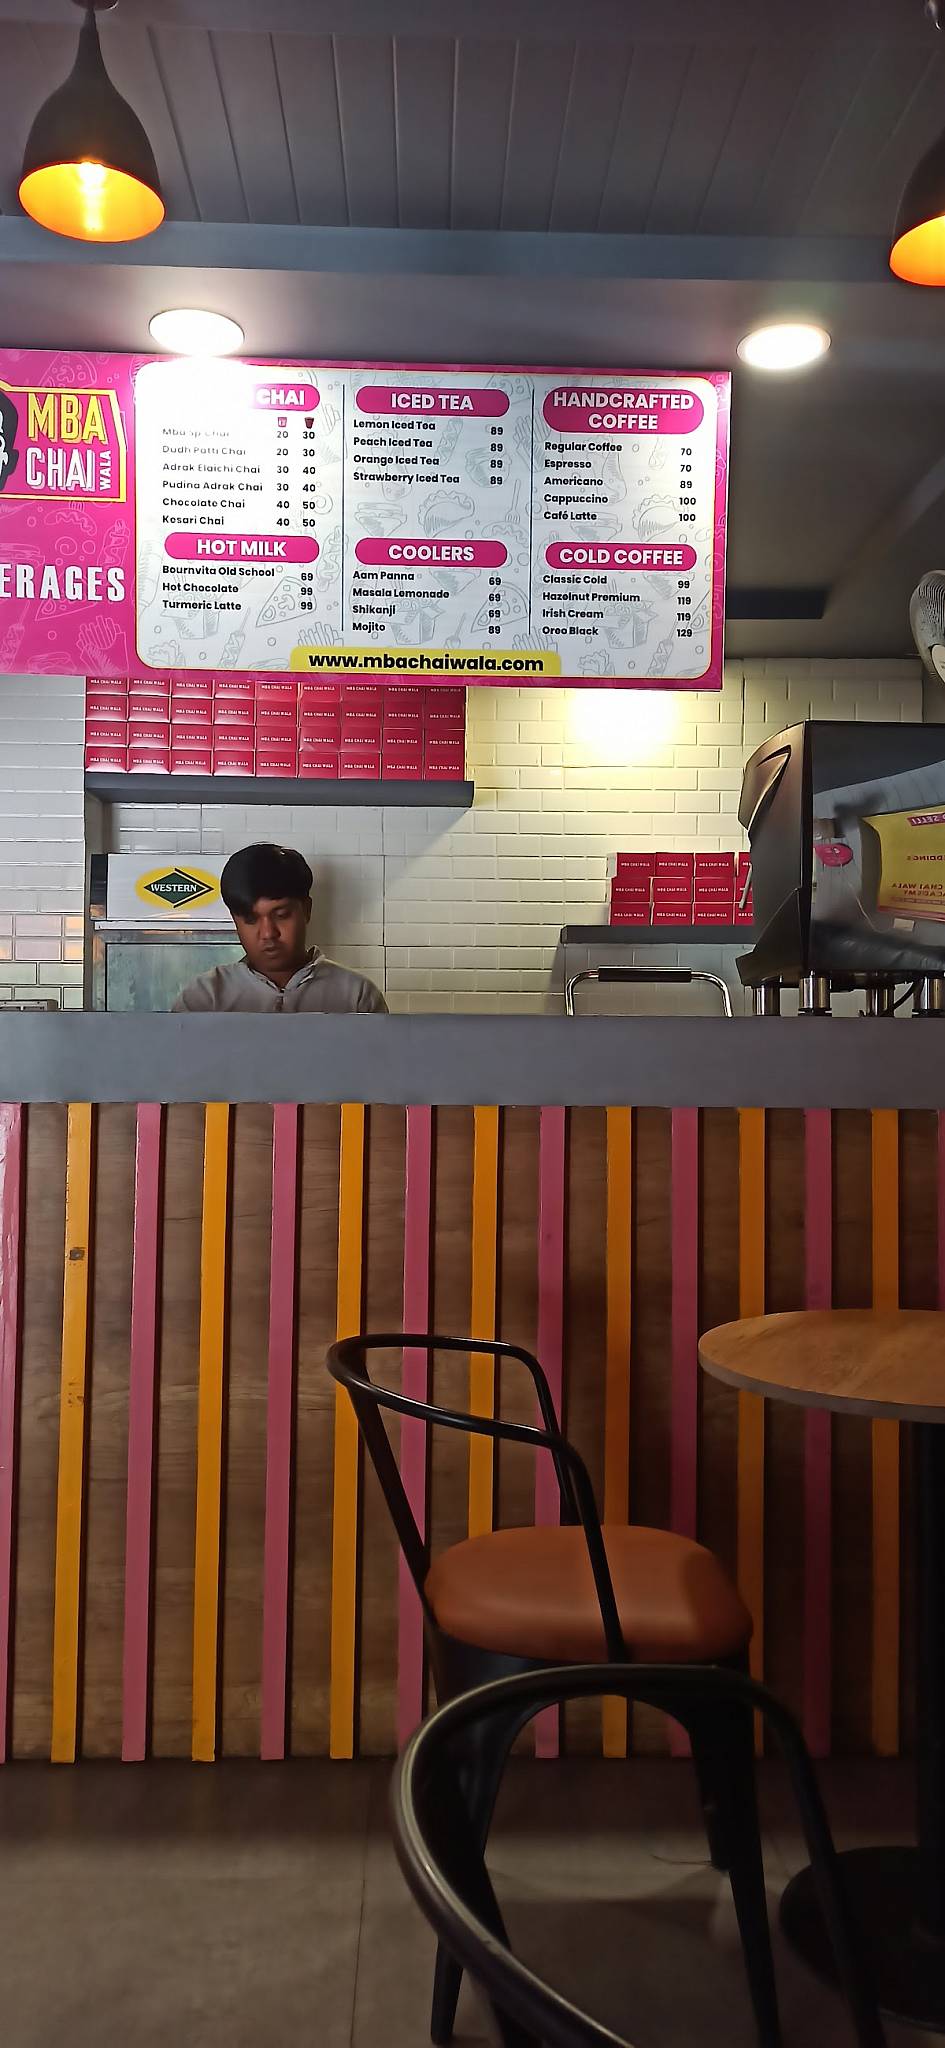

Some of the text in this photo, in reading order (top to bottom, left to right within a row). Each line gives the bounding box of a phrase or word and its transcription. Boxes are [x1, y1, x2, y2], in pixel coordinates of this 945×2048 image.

[256, 388, 305, 406] CHAI
[392, 394, 473, 410] ICED TEA
[553, 391, 694, 410] HANDCRAFTED
[28, 392, 108, 444] MBA
[589, 414, 657, 429] COFFEE
[277, 430, 289, 439] 20
[302, 431, 316, 440] 30
[353, 419, 504, 436] Lemon Iced Tea 89
[162, 445, 191, 453] Dudh
[221, 447, 246, 455] Chai
[276, 448, 289, 457] 20
[303, 448, 315, 457] 30
[353, 436, 504, 453] Peach Iced Tea 89
[544, 441, 692, 456] Regular Coffee 70
[162, 463, 316, 475] Adrak Elaichi Chai 30 40
[353, 454, 503, 469] Orange Iced Tea 89
[544, 458, 692, 473] Espresso 70
[26, 447, 95, 492] CHAI
[99, 450, 111, 491] WALA
[353, 471, 503, 485] Strawberry Iced Tea 89
[543, 475, 693, 489] Americano 89
[162, 480, 316, 493] Pudina Adrak Chai 30 40
[162, 497, 316, 510] Chocolate Chai 40 50
[543, 493, 697, 506] Cappuccino 100
[162, 515, 316, 528] Kesari Chai 40 50
[543, 510, 696, 522] Café Latte 100
[198, 540, 286, 556] HOT MILK
[389, 545, 473, 560] COOLERS
[560, 549, 682, 564] COLD COFFEE
[162, 565, 314, 582] Bournvita Old School 69
[352, 570, 502, 586] Aam Panna 69
[162, 582, 313, 596] Hot Chocolate 99
[542, 574, 690, 589] Classic Cold 99
[352, 587, 501, 602] Masala Lemonade 69
[542, 591, 692, 606] Hazelnut Premium 119
[162, 599, 313, 611] Turmeric Latte 99
[352, 604, 501, 618] Shikanji 69
[542, 607, 691, 622] Irish Cream 119
[352, 621, 501, 635] Mojito 89
[542, 626, 693, 638] Oreo Black 129
[309, 653, 544, 672] www.mbachaiwala.com
[150, 884, 197, 893] WESTERN
